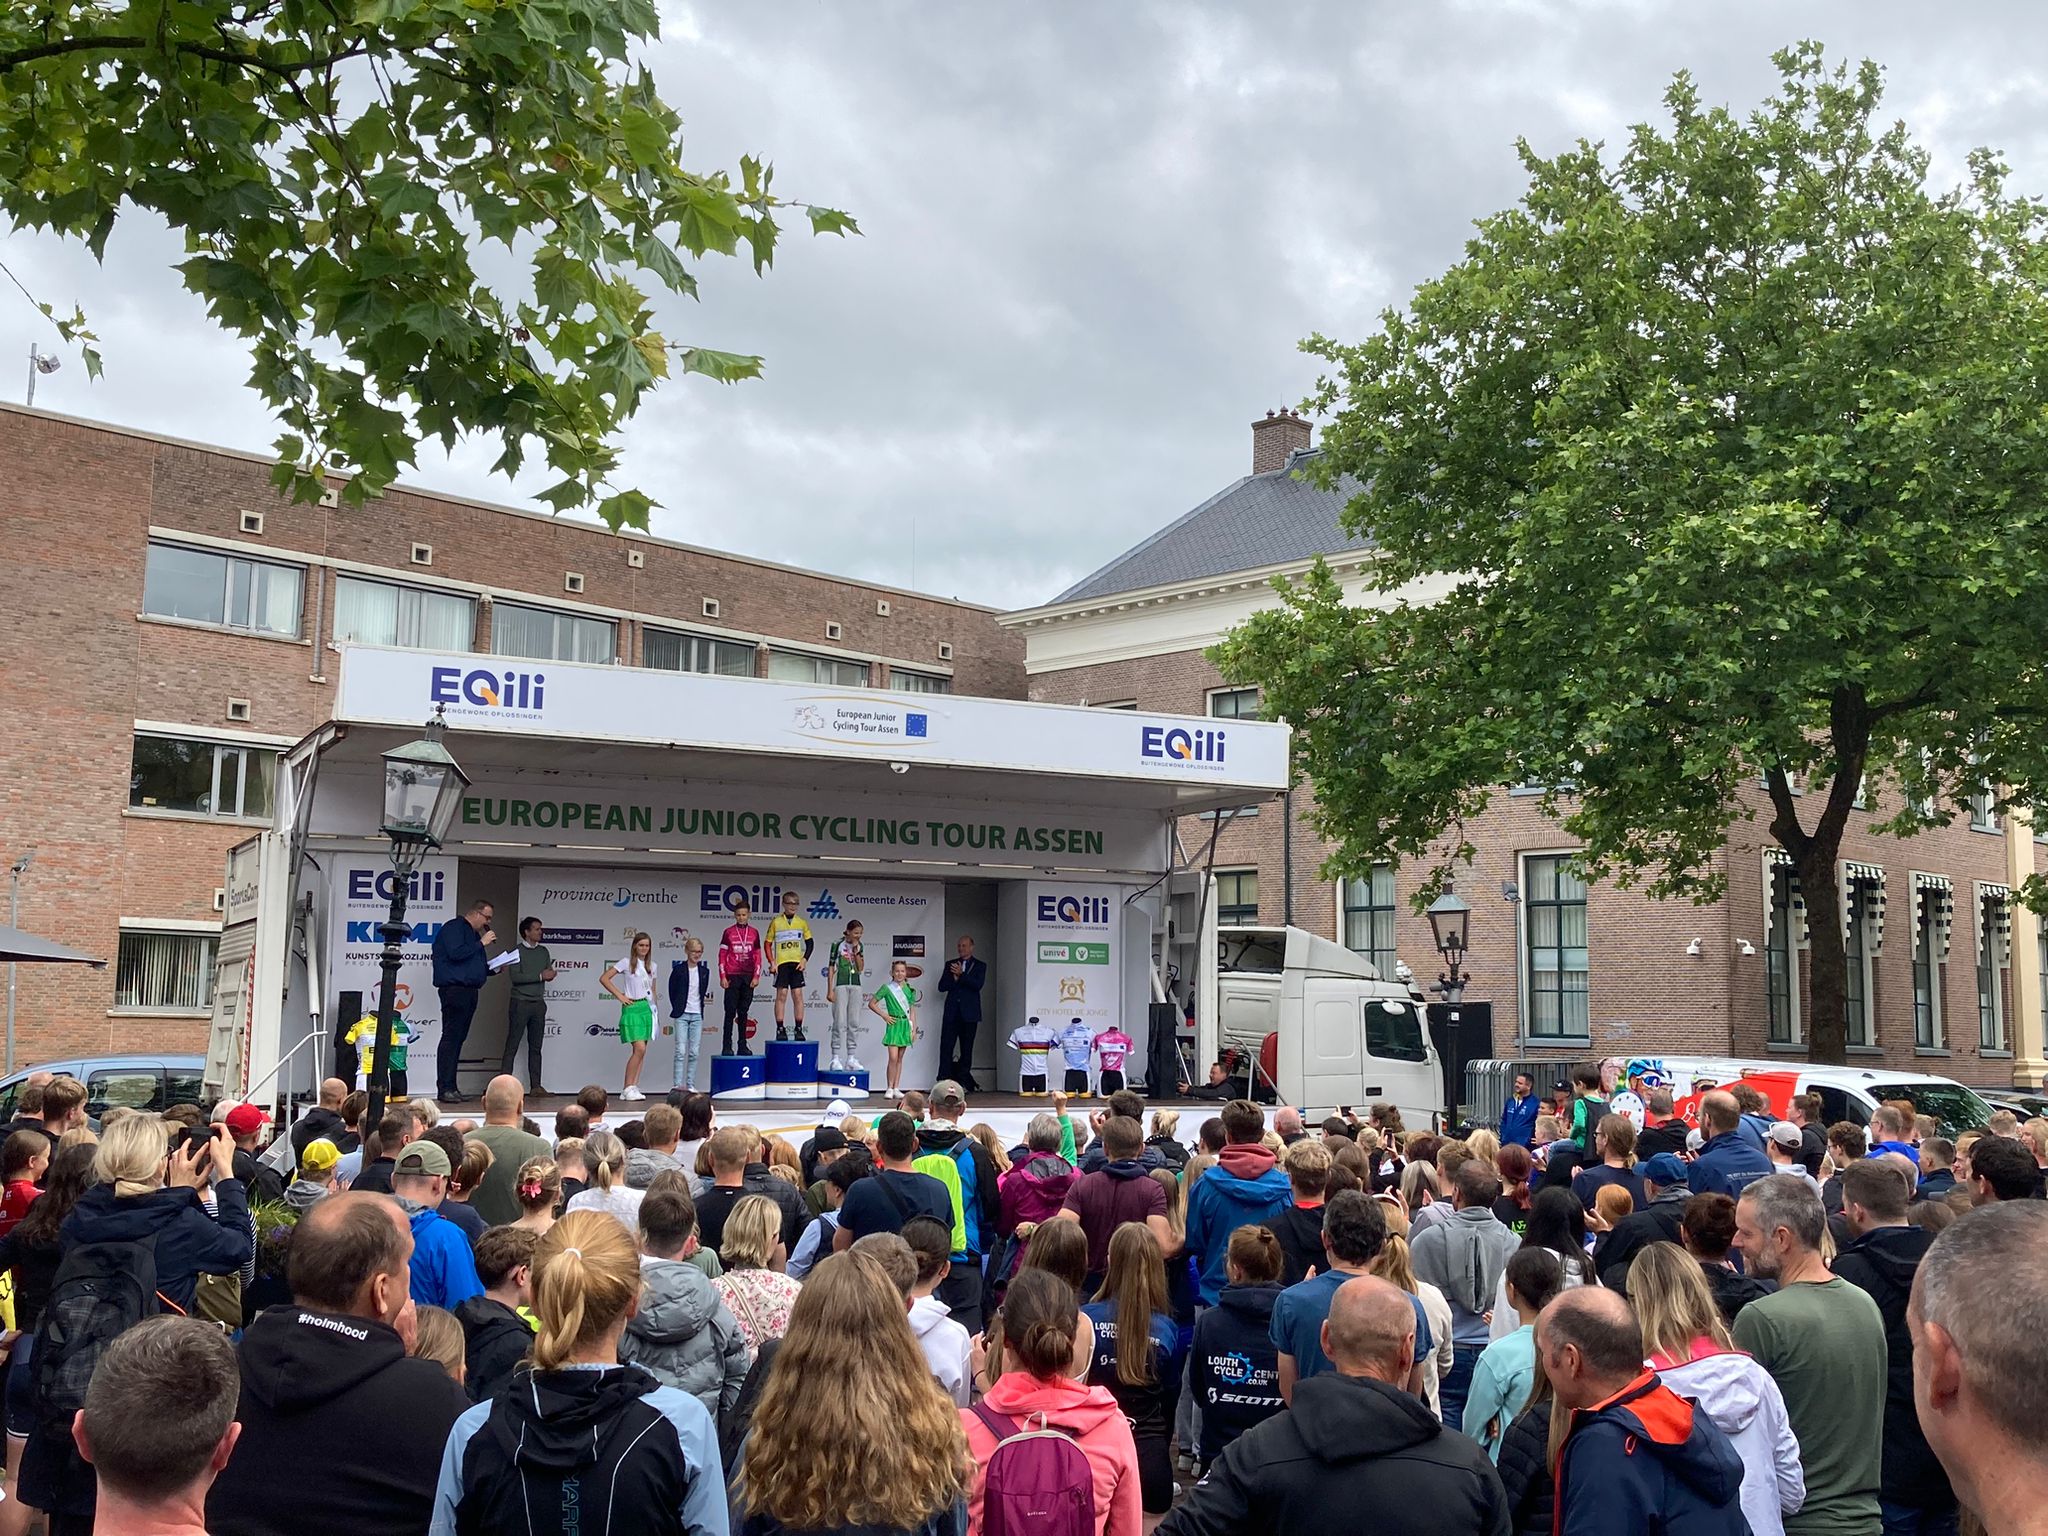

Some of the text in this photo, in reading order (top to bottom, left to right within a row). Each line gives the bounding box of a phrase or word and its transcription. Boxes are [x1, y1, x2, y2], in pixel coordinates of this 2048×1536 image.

[431, 667, 545, 710] EQili
[430, 706, 489, 717] BENGEWONE
[837, 708, 896, 722] European Junior
[833, 720, 899, 734] Cycling Tour Assen
[1142, 726, 1225, 762] EQili
[462, 797, 1104, 855] EUROPEAN JUNIOR CYCLING TOUR ASSEN
[541, 886, 679, 907] provincie Drenthe
[845, 894, 927, 906] Gemeente Assen
[1037, 895, 1109, 923] EQili
[1043, 947, 1066, 957] univé
[796, 1053, 803, 1065] 1
[741, 1066, 750, 1078] 2
[849, 1075, 857, 1087] 3
[298, 1313, 368, 1341] #holmhood
[1101, 1330, 1118, 1339] CYC
[1207, 1355, 1239, 1367] LOUTH
[1213, 1366, 1244, 1378] CYCLE
[1254, 1369, 1280, 1380] CENT
[1219, 1393, 1284, 1406] SCOTT
